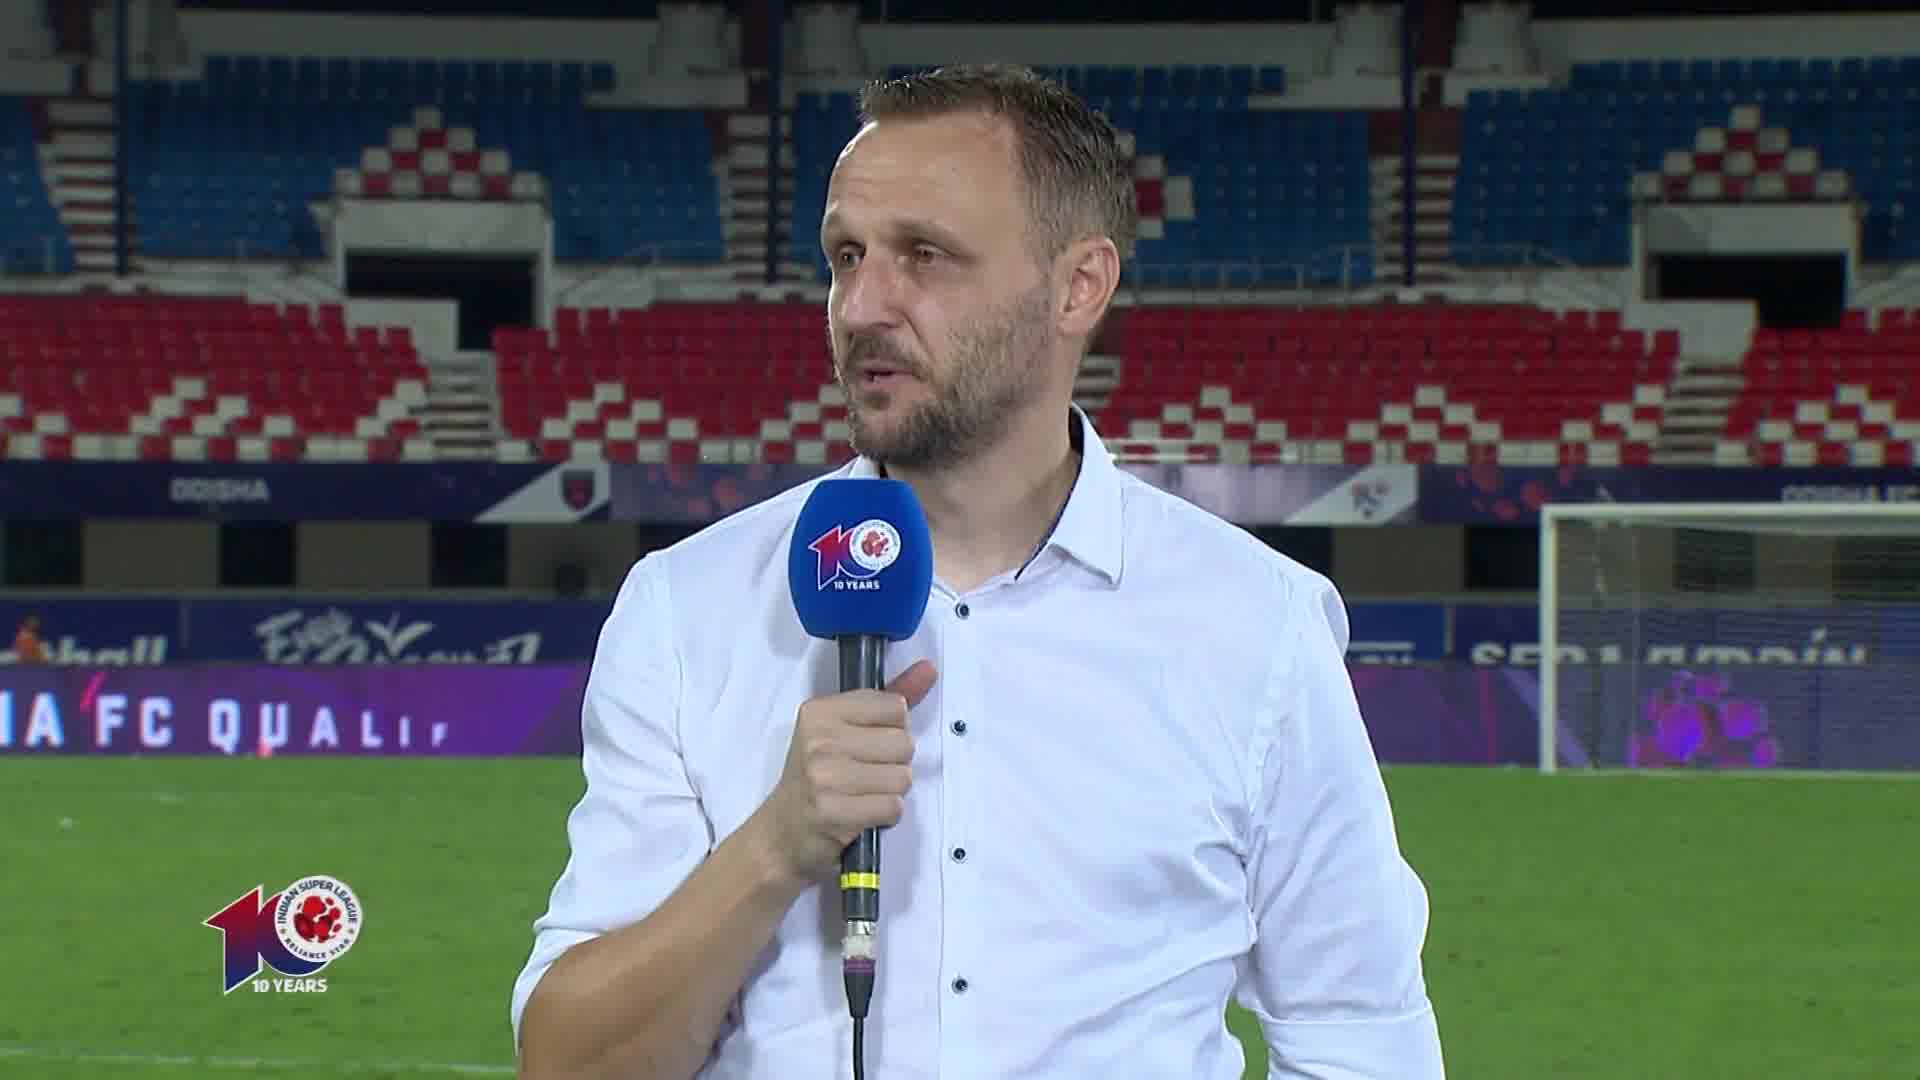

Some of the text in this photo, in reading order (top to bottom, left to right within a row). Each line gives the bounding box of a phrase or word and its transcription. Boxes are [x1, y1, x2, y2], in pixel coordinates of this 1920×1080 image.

[833, 581, 880, 590] 10 YEARS
[96, 694, 173, 748] FC
